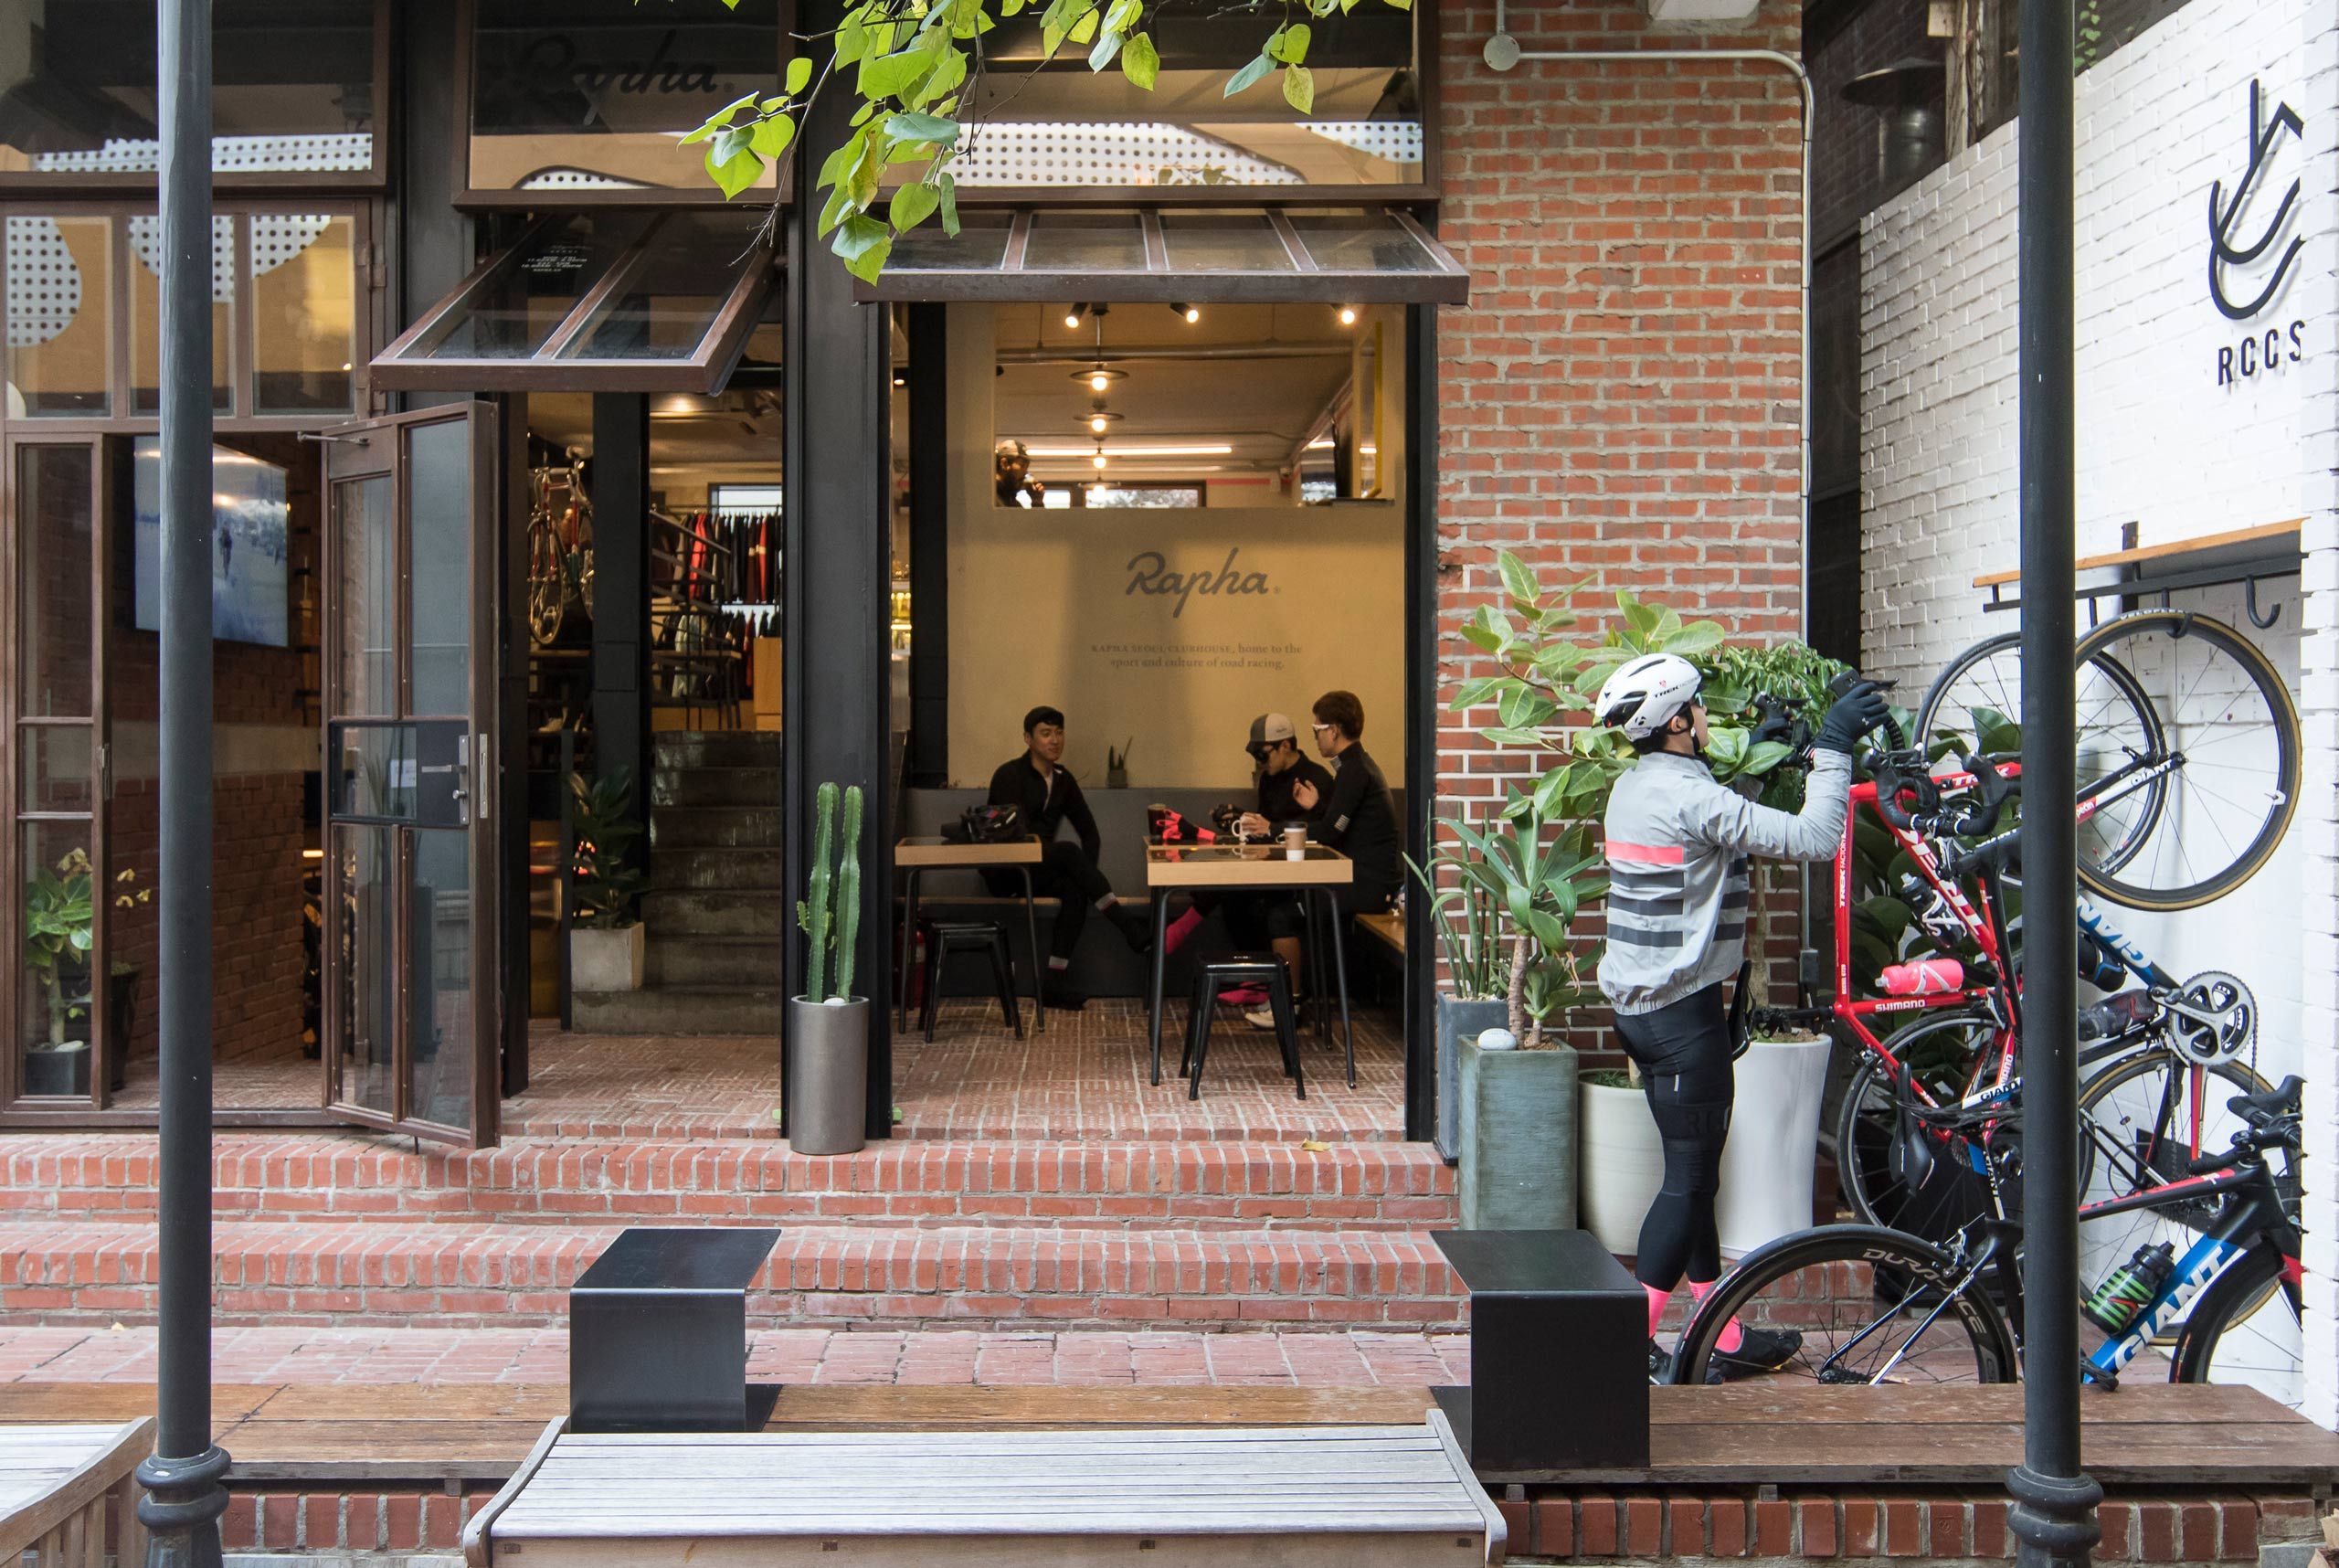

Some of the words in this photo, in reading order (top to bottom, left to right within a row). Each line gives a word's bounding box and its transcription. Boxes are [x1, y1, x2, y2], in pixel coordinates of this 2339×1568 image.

[2218, 320, 2305, 386] RCCS
[1127, 547, 1269, 618] Rapha
[1110, 658, 1139, 669] sport
[1141, 657, 1161, 667] and
[1206, 657, 1217, 667] of
[1220, 657, 1244, 667] road
[1238, 642, 1268, 653] home
[1271, 644, 1282, 653] to
[1285, 642, 1302, 653] the
[2076, 895, 2152, 969] GIAN
[1875, 999, 1926, 1012] SHIMANO
[2115, 1245, 2224, 1371] GIANT
